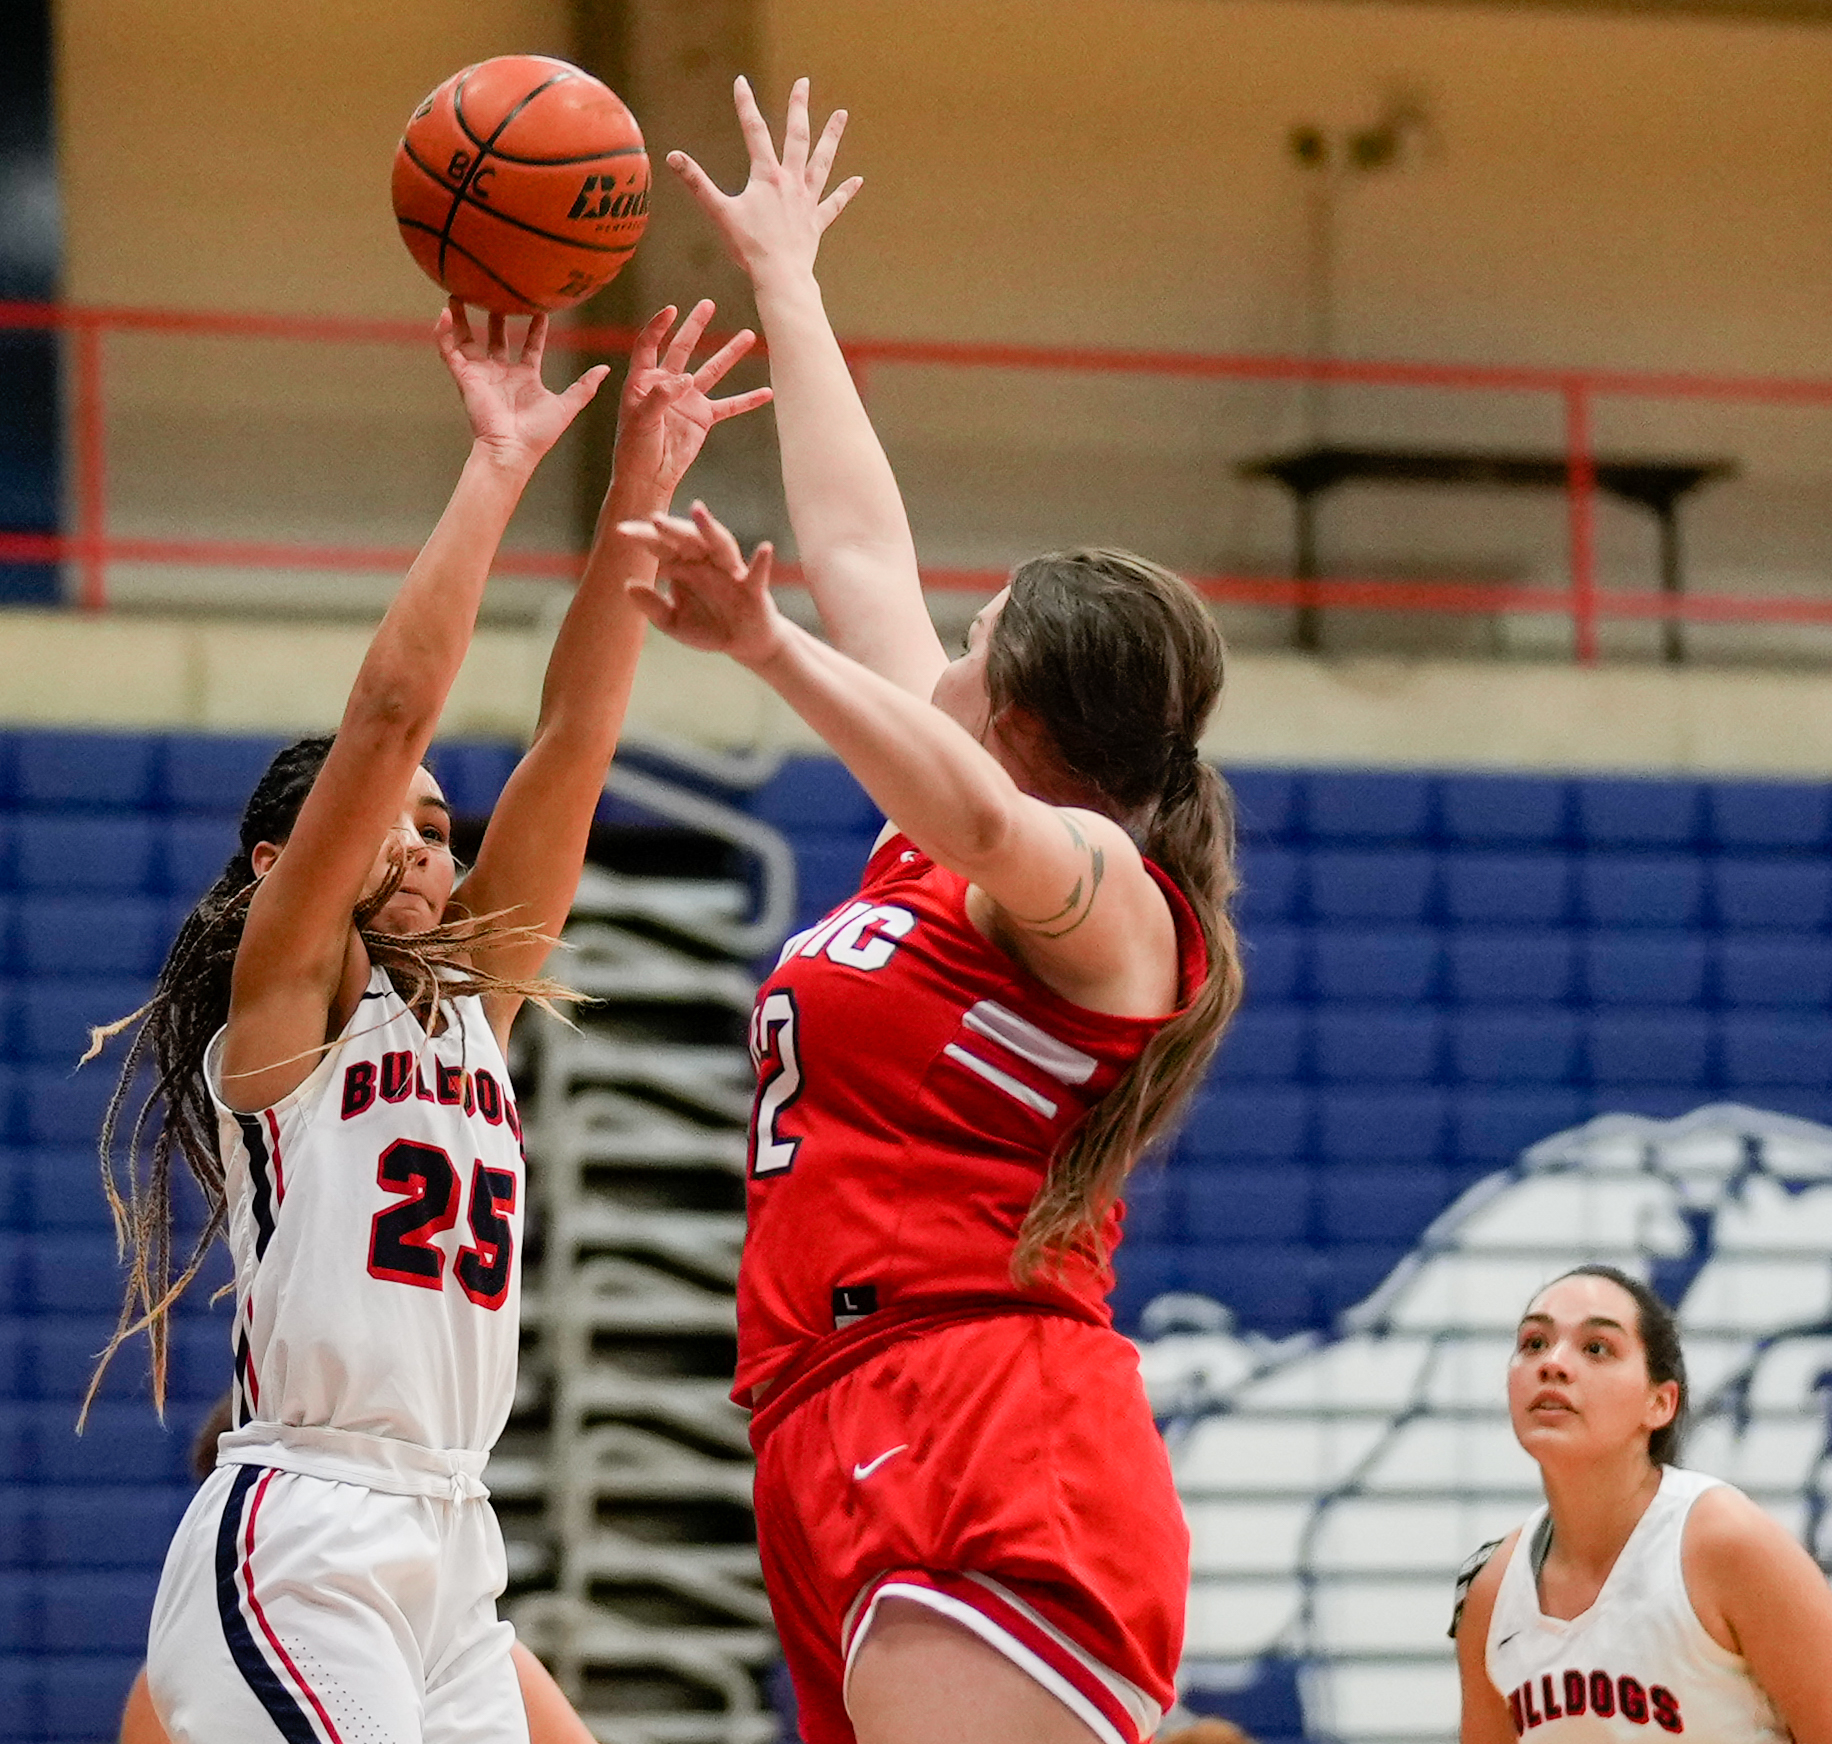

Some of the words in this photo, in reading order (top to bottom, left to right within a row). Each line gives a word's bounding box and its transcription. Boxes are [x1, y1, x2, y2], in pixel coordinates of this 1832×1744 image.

[367, 1138, 517, 1311] 25
[843, 1292, 858, 1310] L
[1508, 1667, 1684, 1737] LLDOGS
